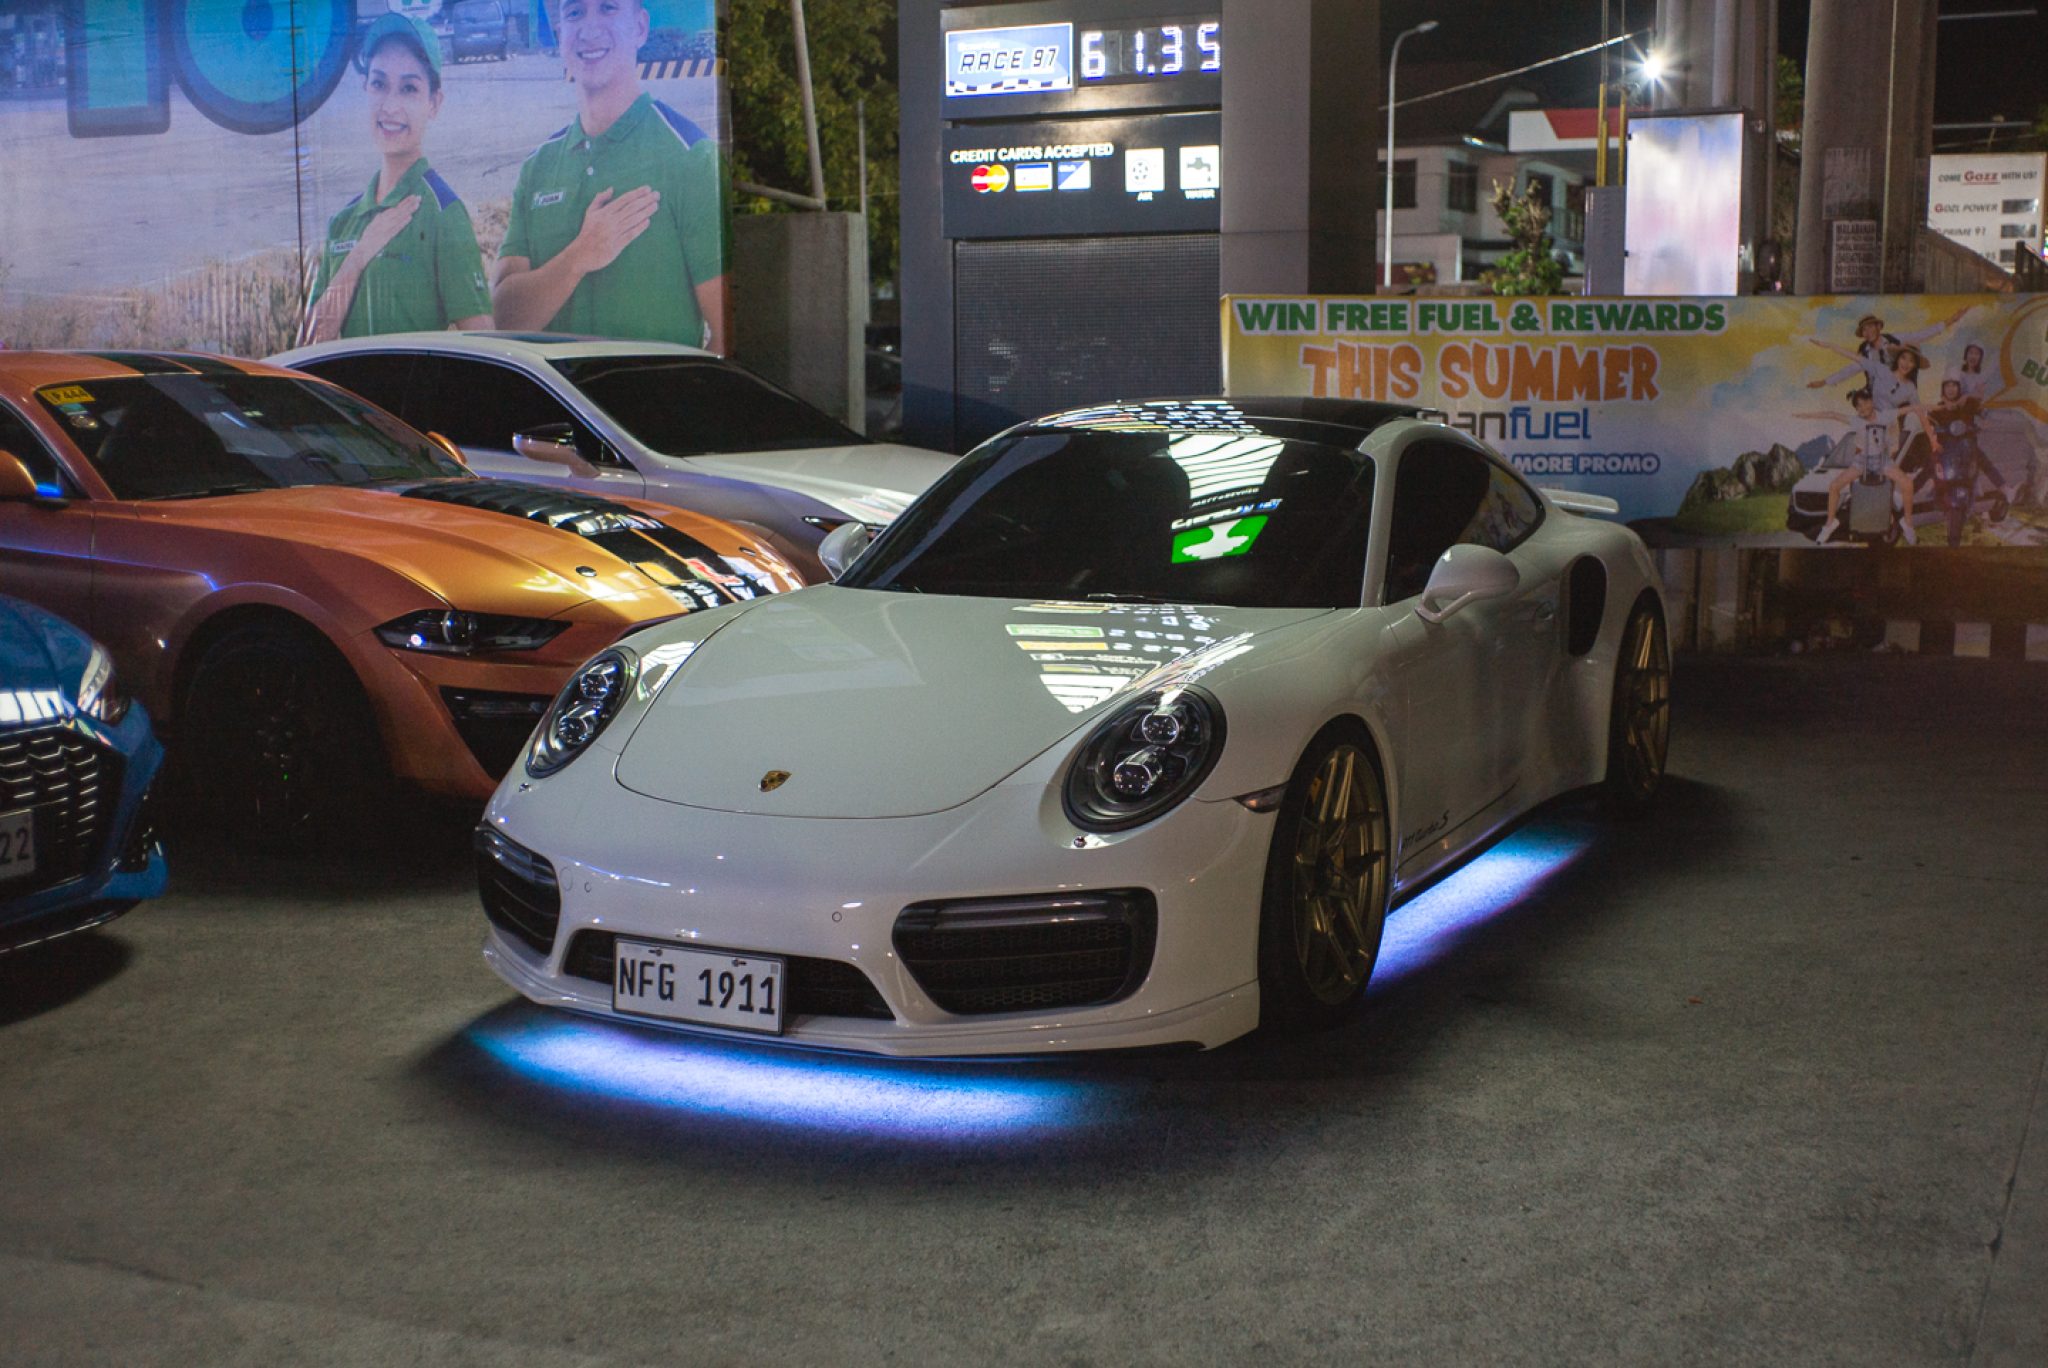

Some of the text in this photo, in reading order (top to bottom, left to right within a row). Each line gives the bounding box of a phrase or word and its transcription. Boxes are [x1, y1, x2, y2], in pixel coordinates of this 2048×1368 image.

[960, 47, 1056, 72] RACE 97
[950, 142, 1114, 163] CREDIT CARDS ACCEPTED
[2001, 171, 2021, 180] WITH
[1963, 203, 1998, 213] POWER
[1237, 303, 1726, 331] WIN FREE FUEL & REWARDS
[1302, 341, 1660, 401] THIS SUMMER
[1513, 456, 1660, 473] MORE PROMO
[619, 957, 775, 1015] NFG 1911
